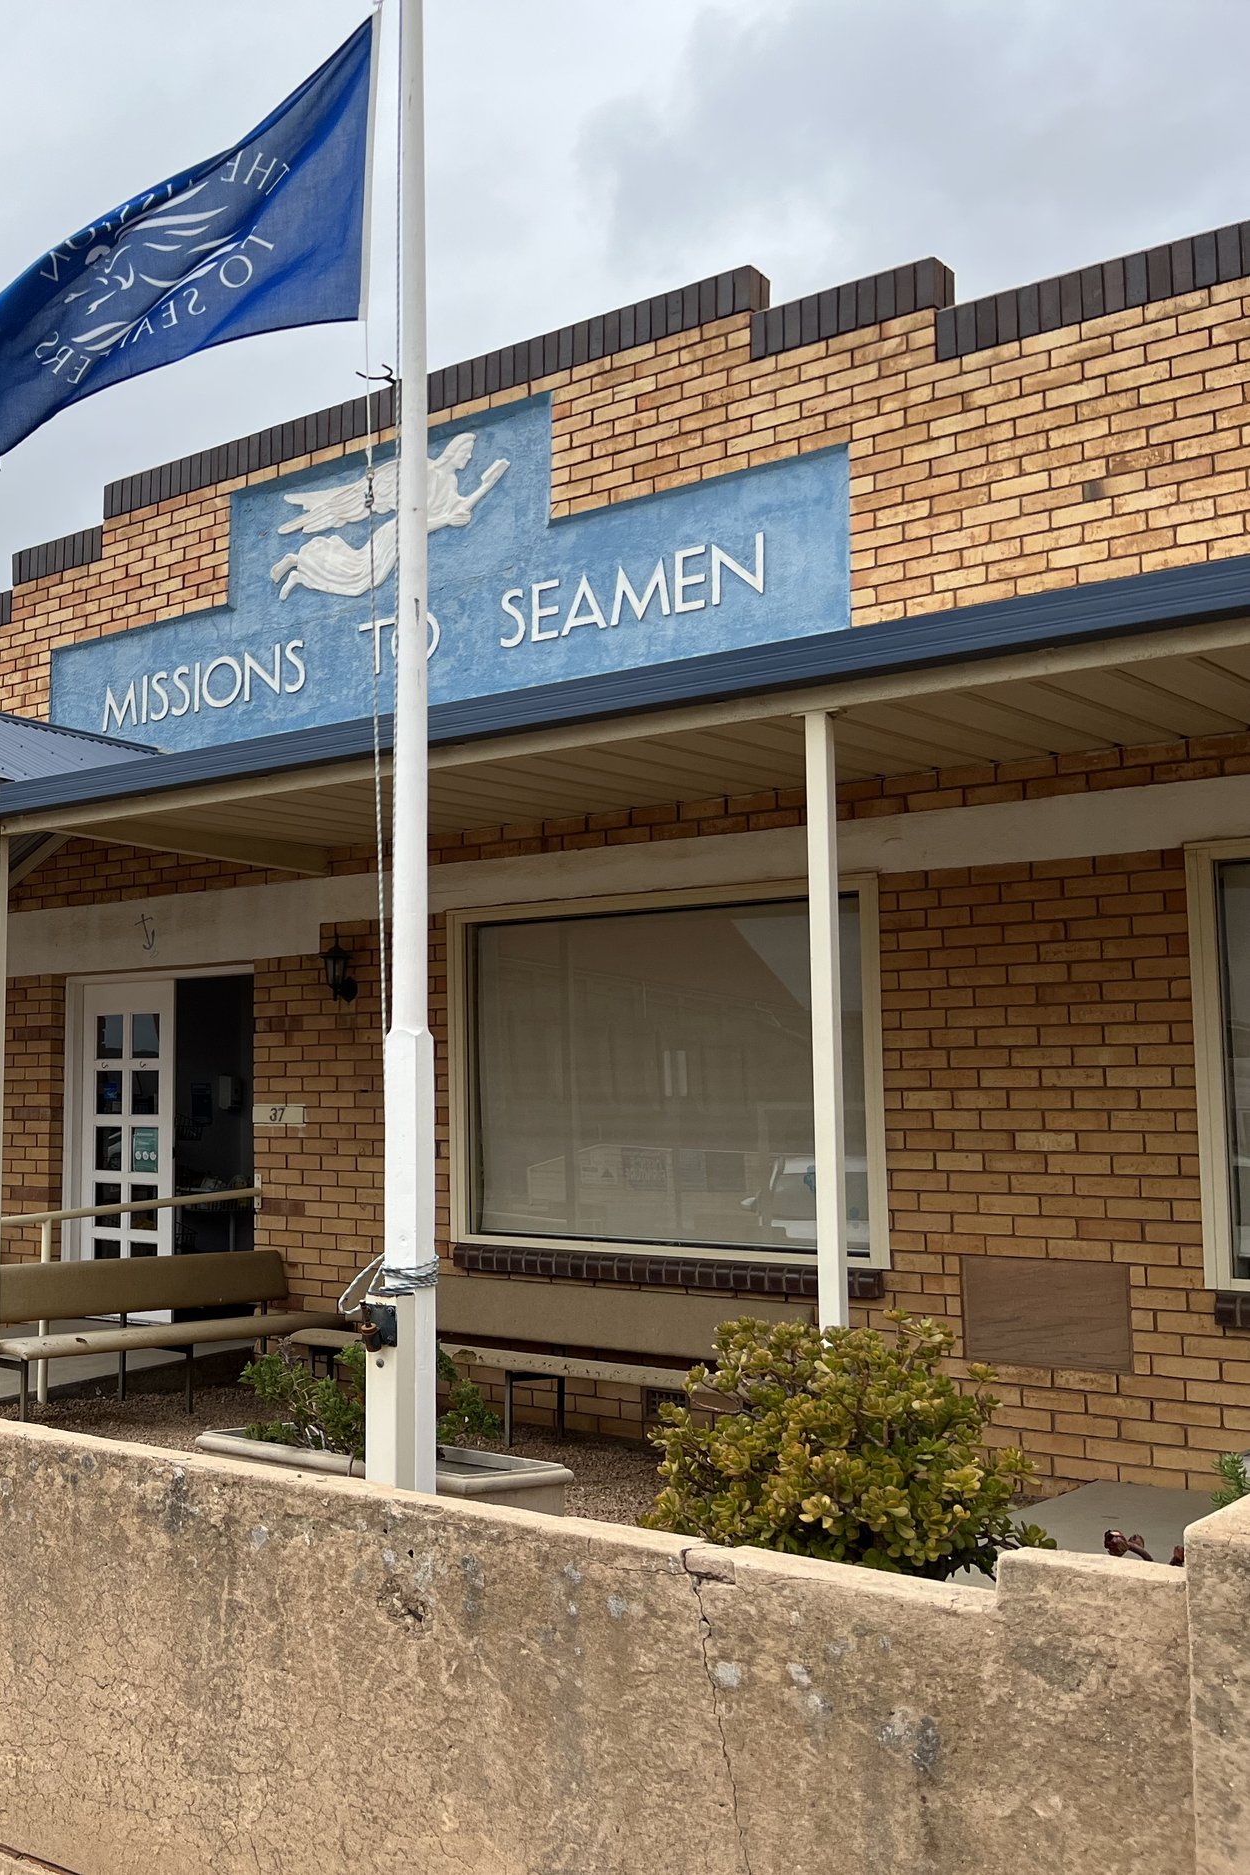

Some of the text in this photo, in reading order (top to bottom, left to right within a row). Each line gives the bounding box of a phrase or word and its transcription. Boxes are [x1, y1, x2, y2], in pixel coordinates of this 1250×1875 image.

[102, 639, 307, 733] MISSIONS
[500, 531, 764, 648] SEAMEN
[269, 1107, 286, 1123] 37
